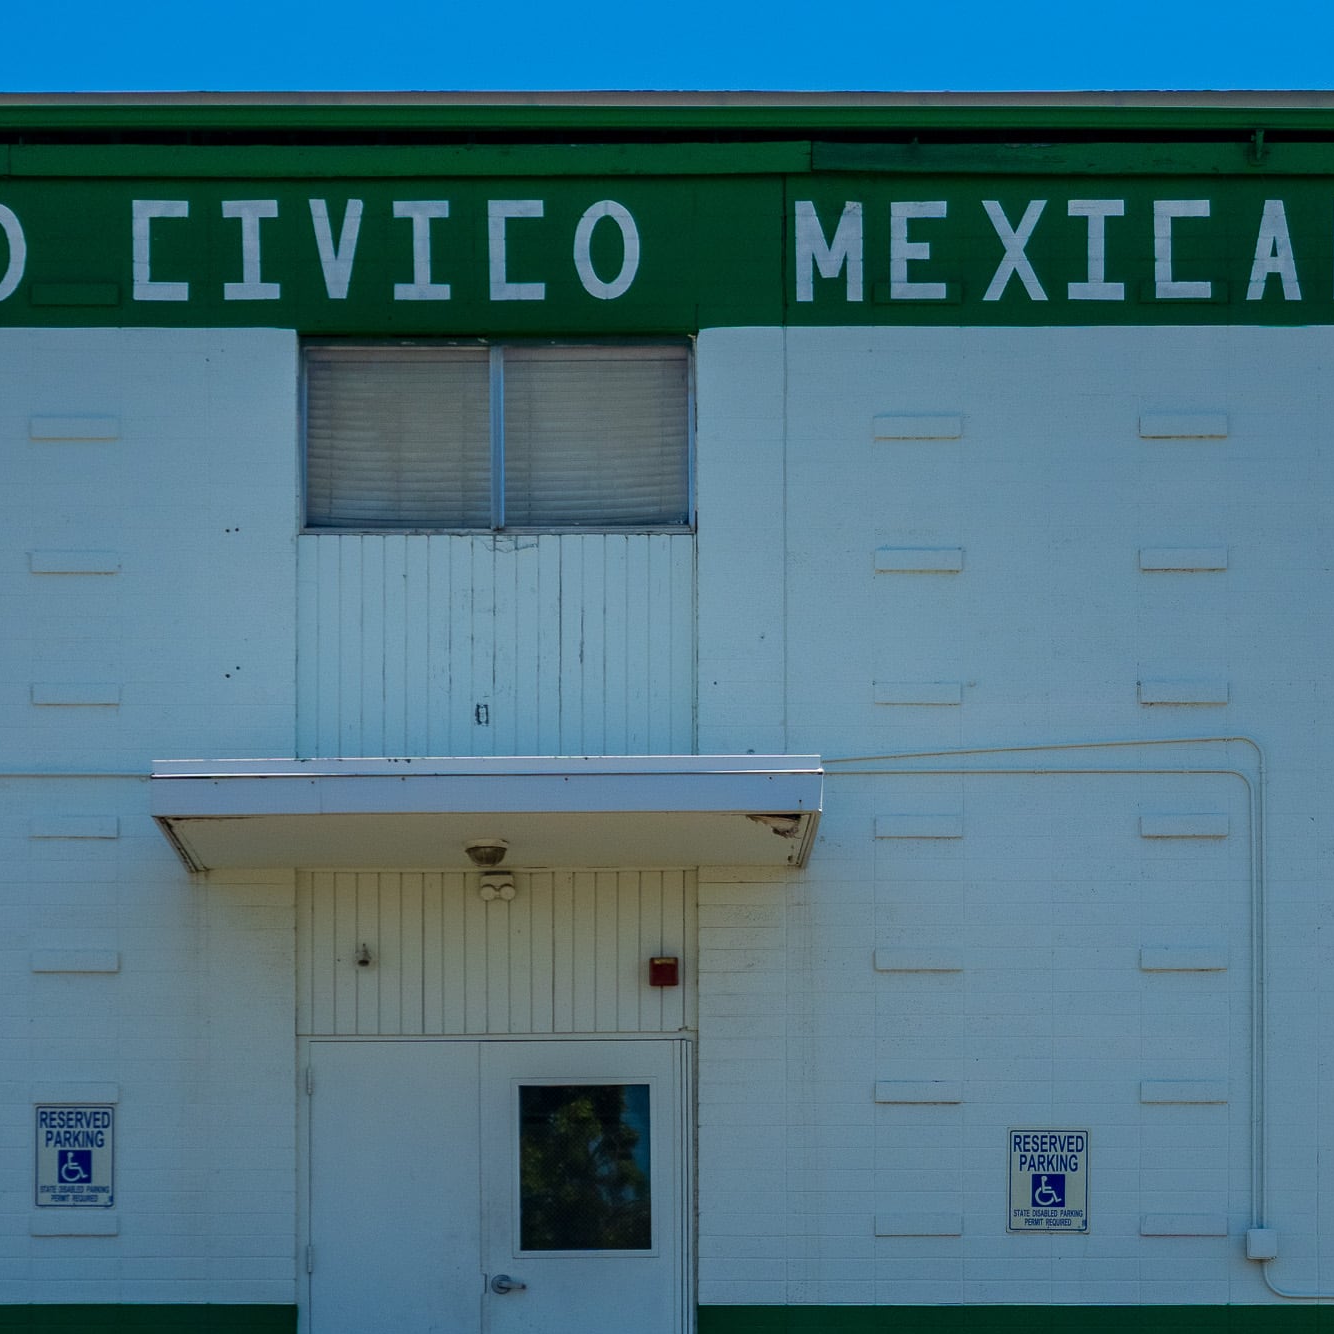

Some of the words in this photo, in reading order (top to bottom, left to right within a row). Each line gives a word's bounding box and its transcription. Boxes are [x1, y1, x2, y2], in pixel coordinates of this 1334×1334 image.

[130, 195, 642, 303] CIVICO
[40, 1111, 110, 1128] RESERVED
[46, 1130, 104, 1147] PARKING
[1014, 1135, 1084, 1152] RESERVED
[1019, 1154, 1079, 1172] PARKING
[1013, 1209, 1030, 1218] STATE
[1032, 1209, 1058, 1218] DISABLED
[1060, 1209, 1084, 1218] PARKING
[1024, 1218, 1044, 1226] PERMIT
[1045, 1218, 1072, 1227] REQUIRED
